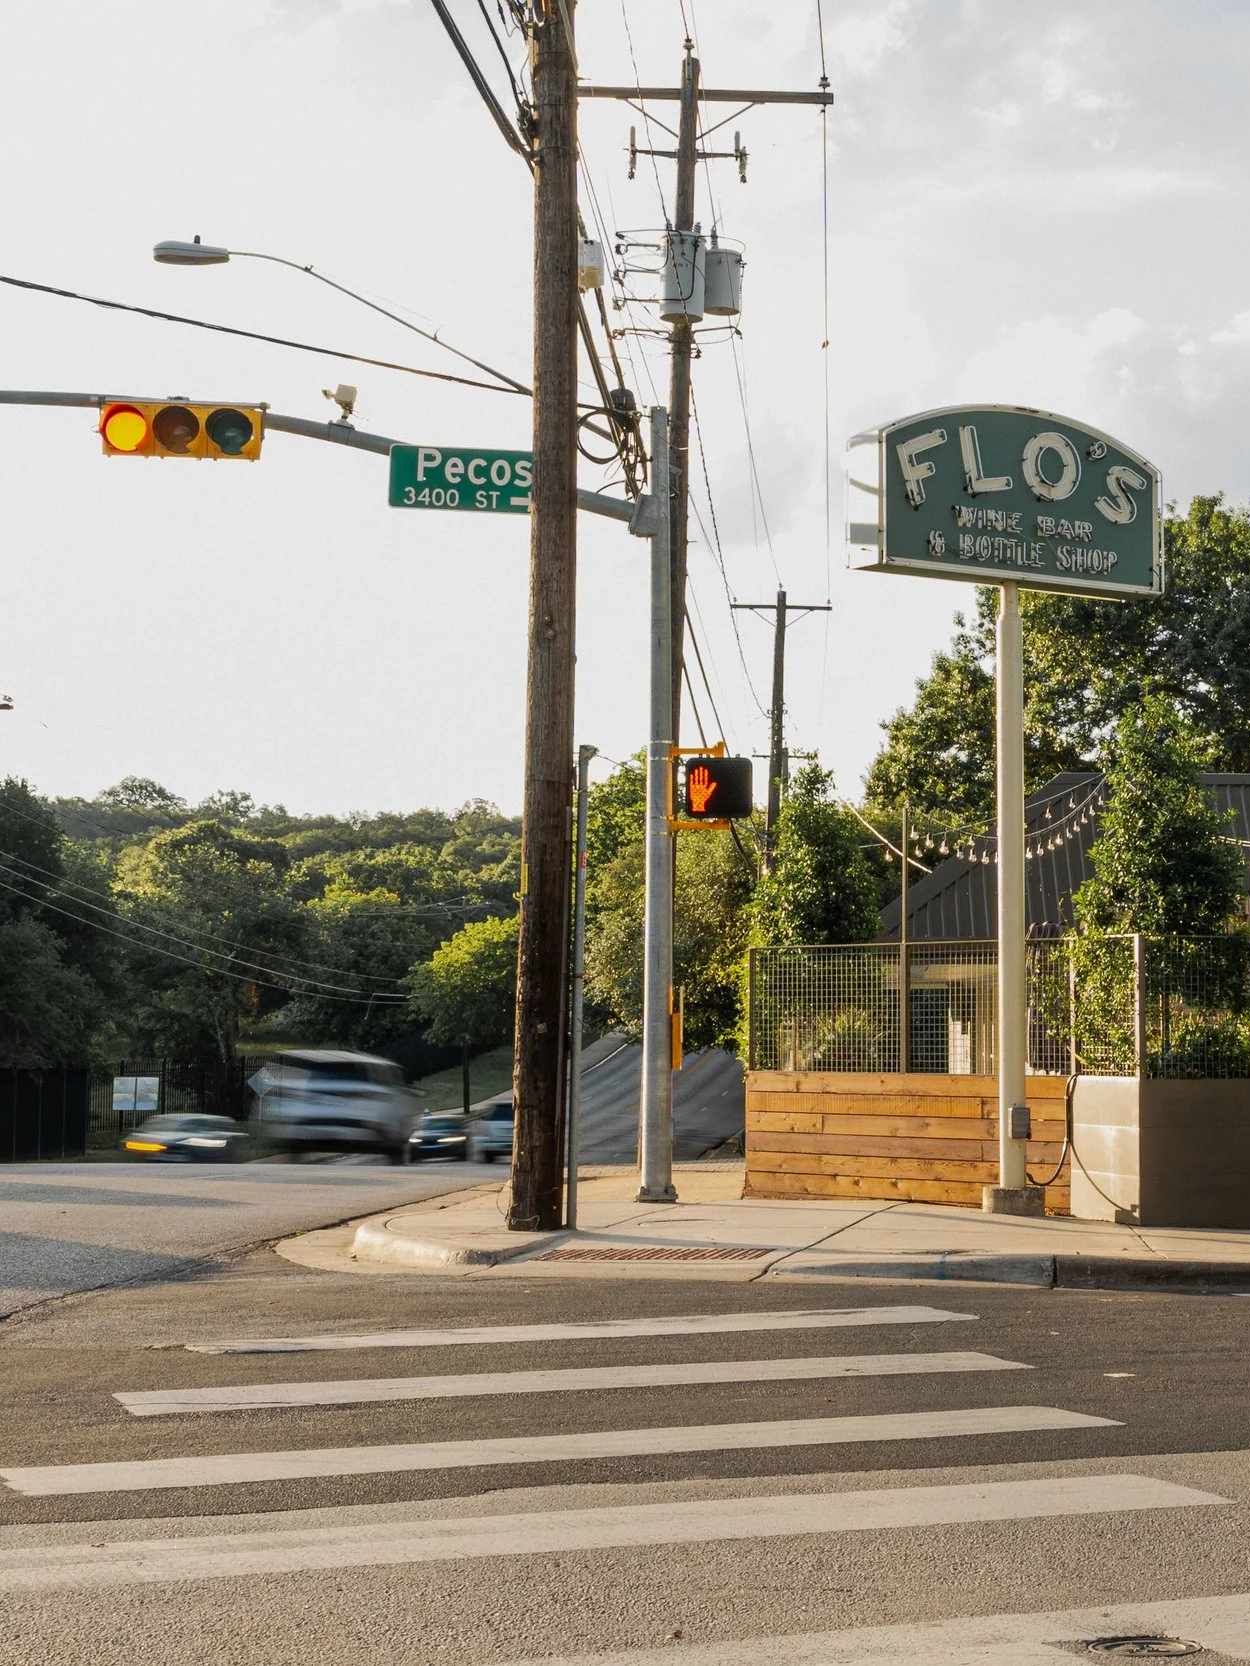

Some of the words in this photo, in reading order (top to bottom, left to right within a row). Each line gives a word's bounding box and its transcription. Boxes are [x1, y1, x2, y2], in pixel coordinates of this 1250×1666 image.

[416, 447, 533, 488] Pecos
[896, 425, 1148, 525] FLO'S
[403, 486, 460, 507] 3400
[475, 490, 501, 509] ST
[953, 505, 1023, 533] WINE
[1037, 515, 1093, 543] BAR
[928, 530, 946, 557] &
[959, 533, 1047, 567] BOTTLE
[1056, 545, 1118, 575] SHOP
